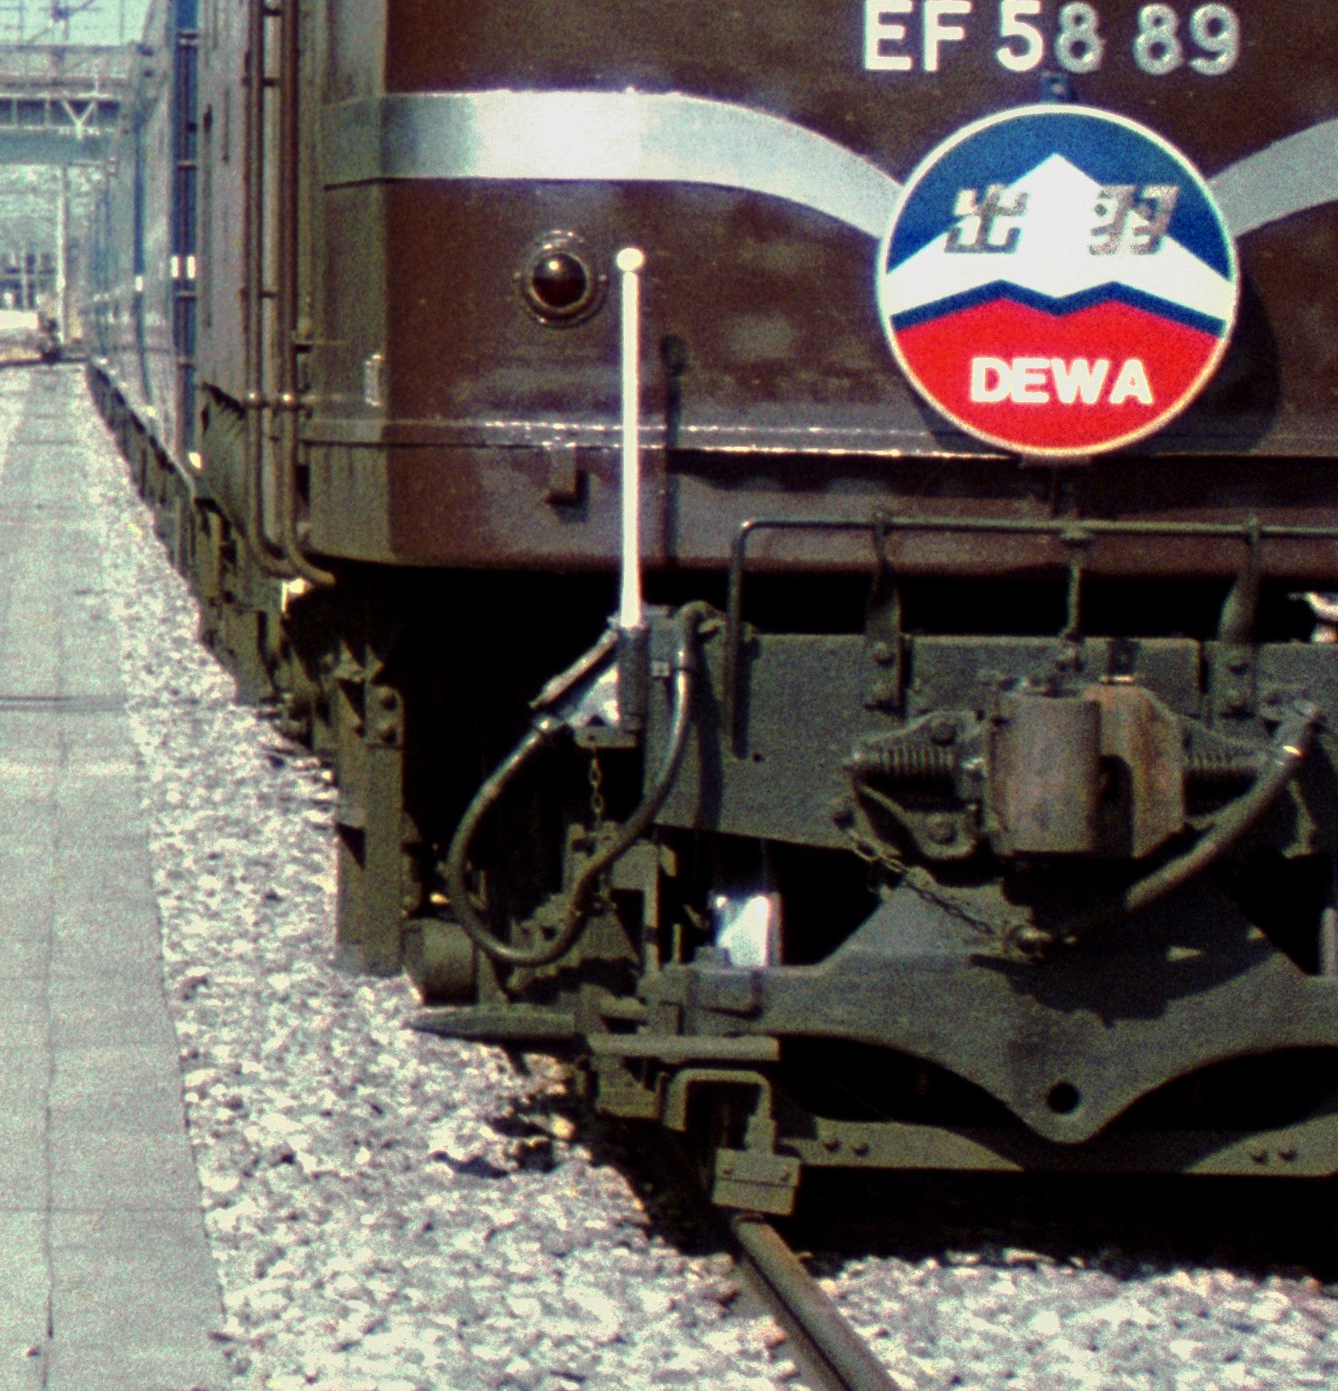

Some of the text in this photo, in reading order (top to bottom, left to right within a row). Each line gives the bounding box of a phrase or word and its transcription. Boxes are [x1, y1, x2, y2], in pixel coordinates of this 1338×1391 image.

[1134, 3, 1241, 76] 89
[943, 183, 1180, 256] 出羽
[970, 357, 1153, 404] DEWA
